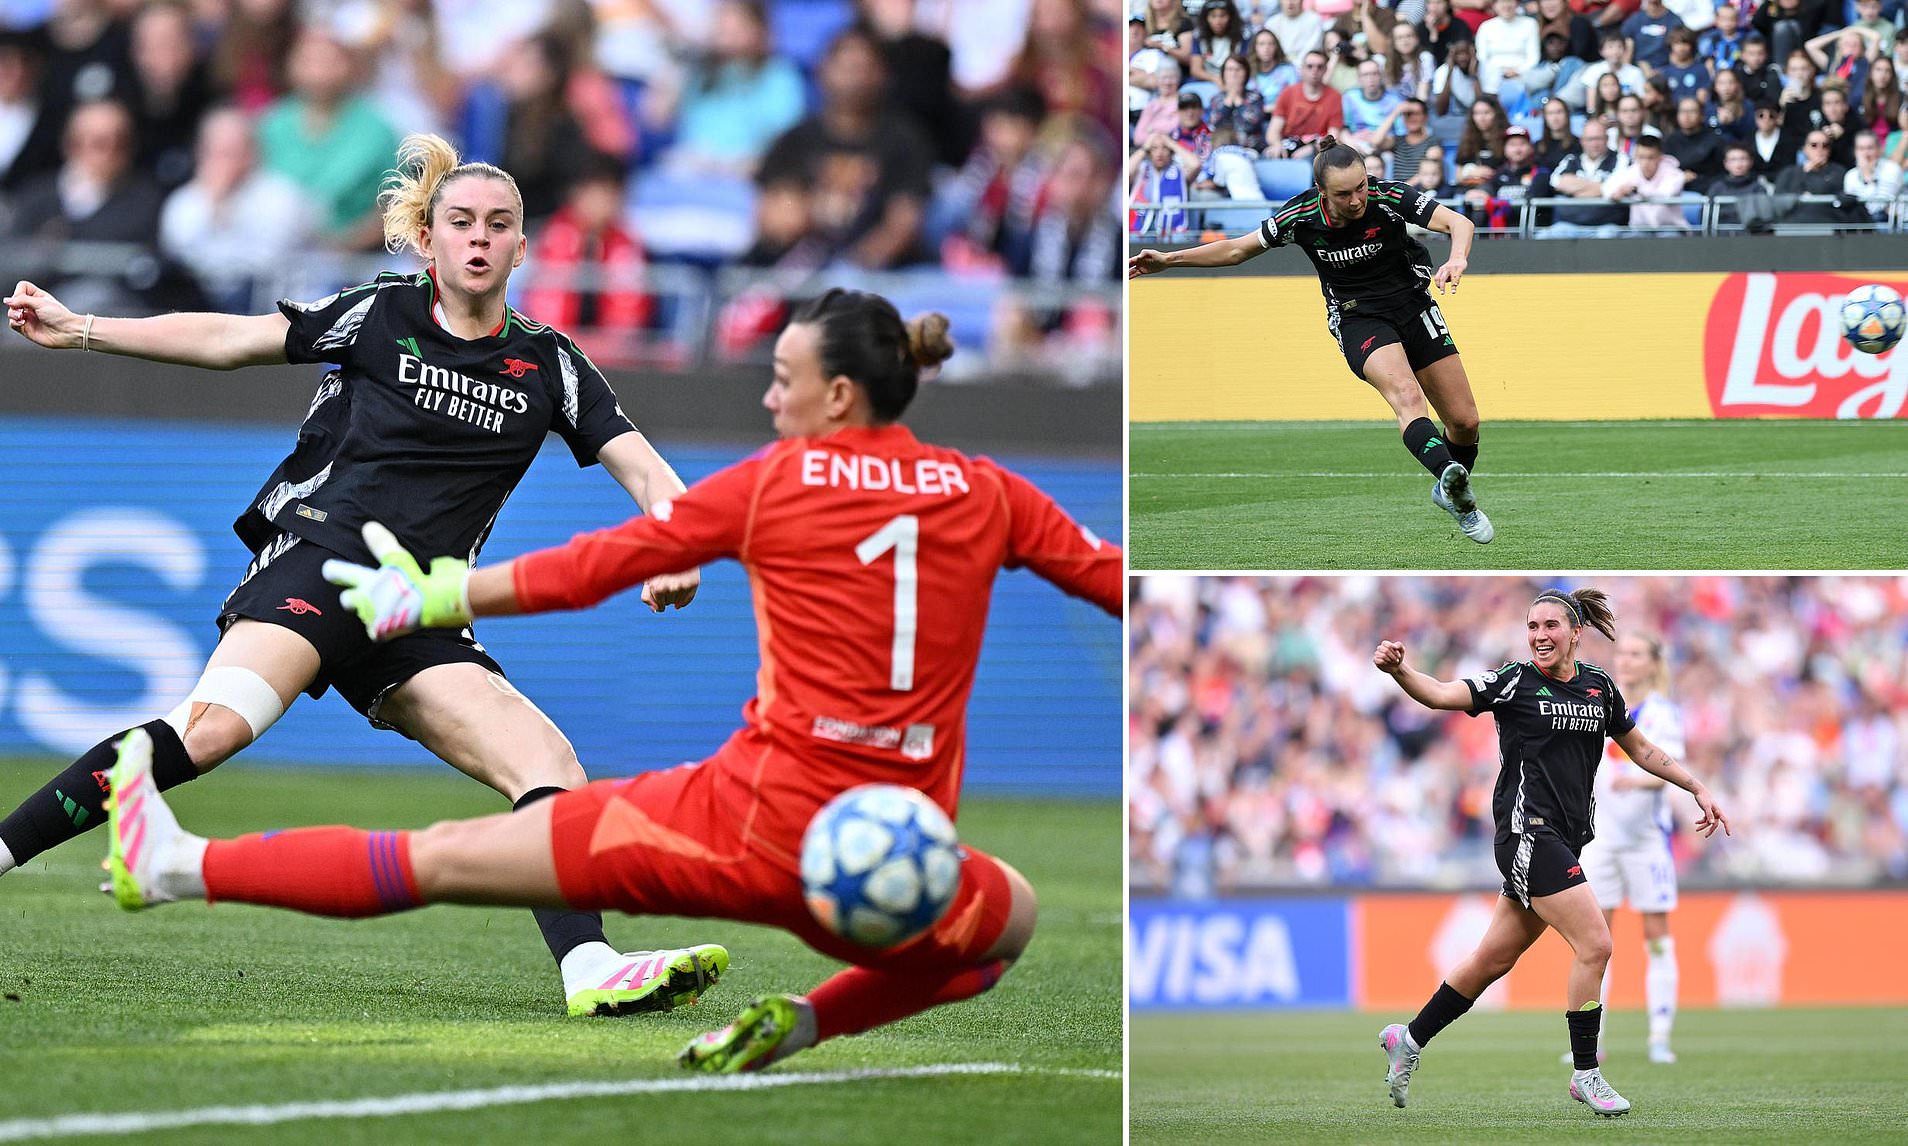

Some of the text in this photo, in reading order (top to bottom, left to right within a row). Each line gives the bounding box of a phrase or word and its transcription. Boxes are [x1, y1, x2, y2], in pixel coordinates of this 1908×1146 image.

[1420, 305, 1449, 340] 19
[398, 353, 529, 414] Emirates
[414, 388, 504, 434] FLY BETTER
[802, 451, 970, 496] ENDLER
[854, 514, 919, 692] 1
[0, 507, 206, 755] S
[1538, 700, 1605, 719] Emirates
[1551, 716, 1599, 733] FLY BETTER
[1129, 914, 1301, 1003] VISA
